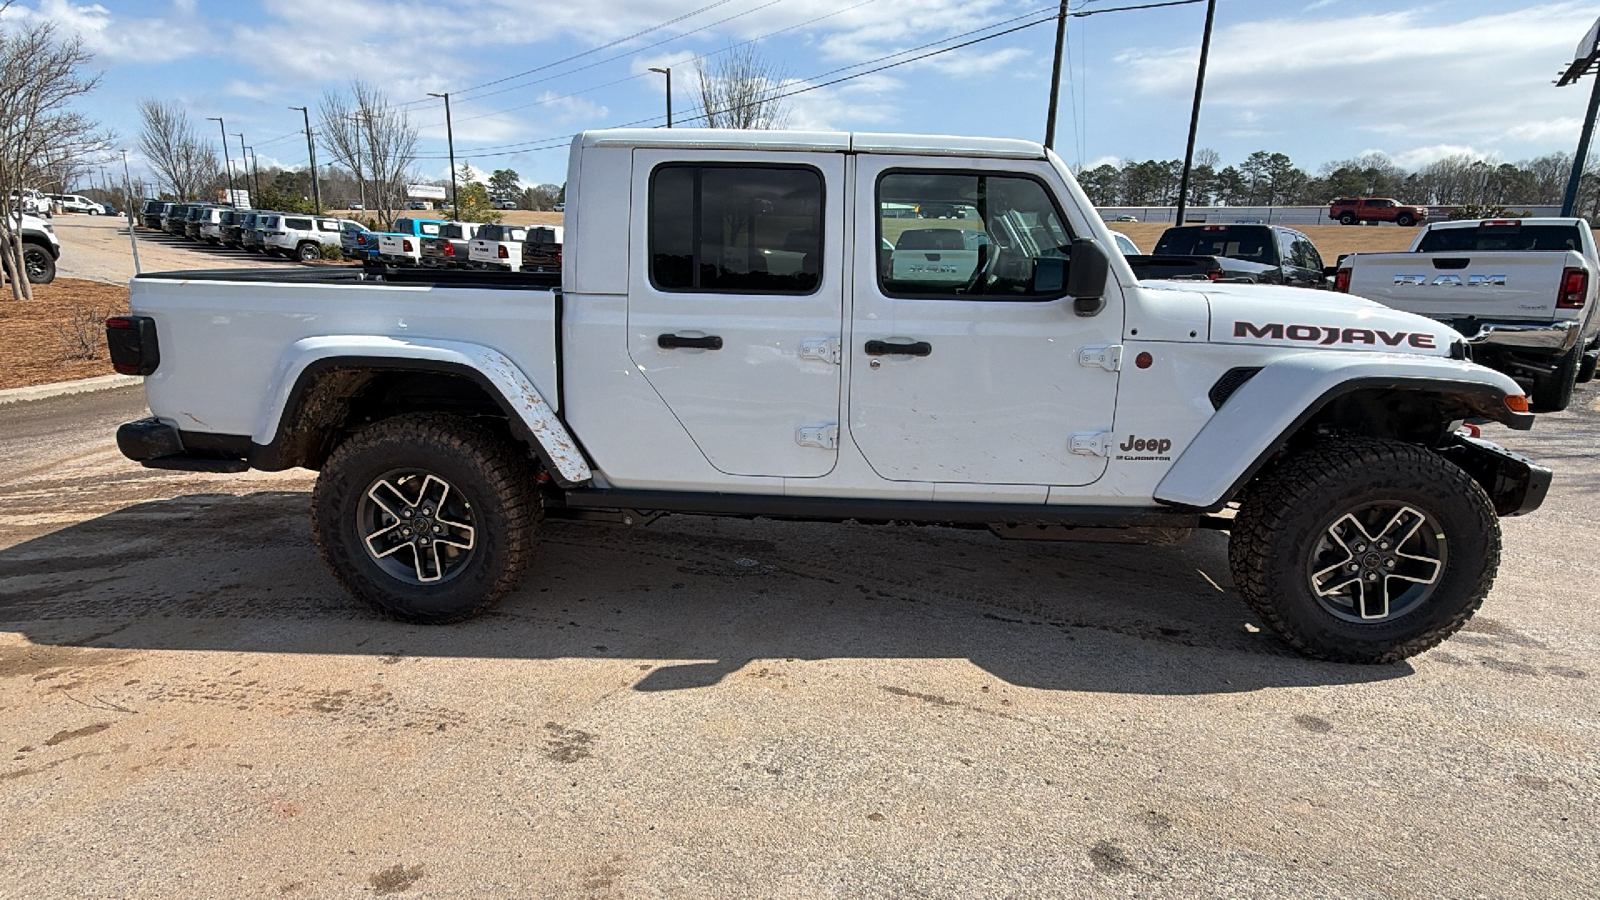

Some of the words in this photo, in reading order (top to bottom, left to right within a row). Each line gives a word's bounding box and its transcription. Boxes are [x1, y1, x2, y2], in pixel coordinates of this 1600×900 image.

[1393, 274, 1508, 287] RAM
[1233, 321, 1437, 349] MOJAVE
[1119, 434, 1172, 455] Jeep
